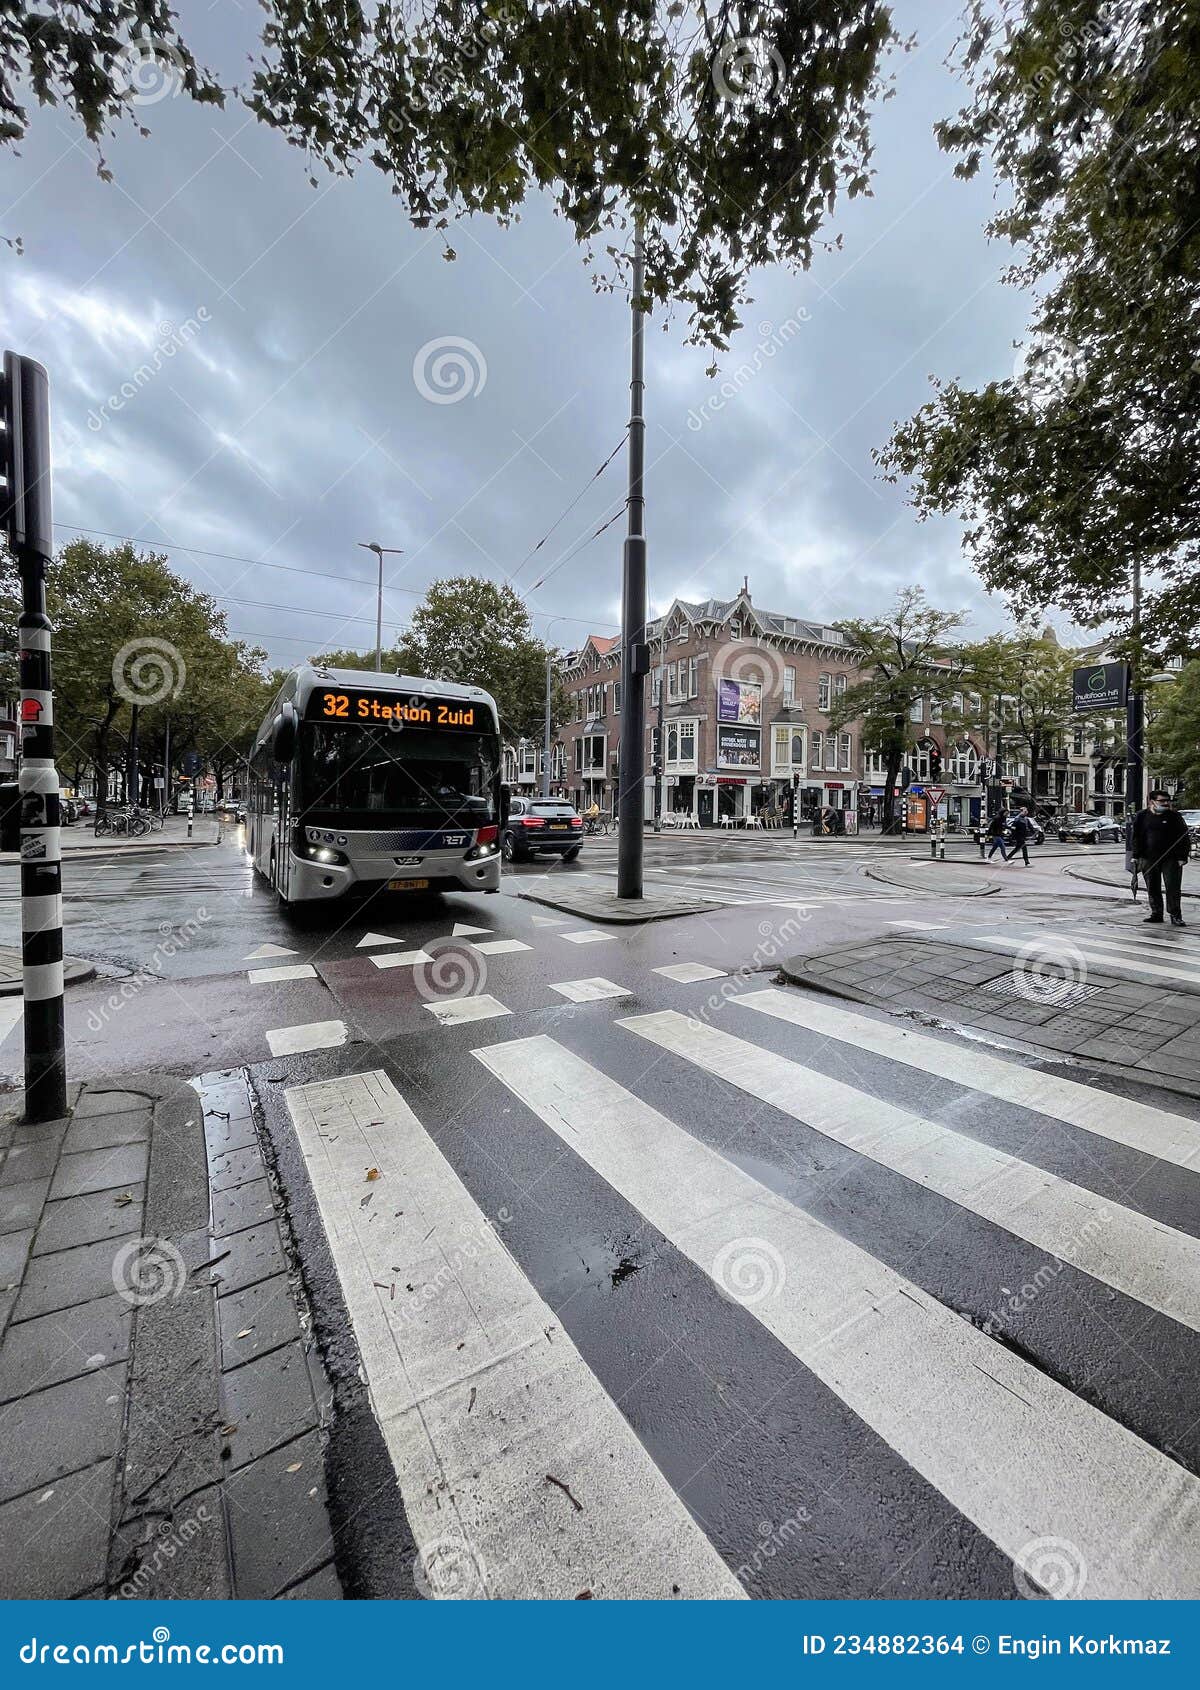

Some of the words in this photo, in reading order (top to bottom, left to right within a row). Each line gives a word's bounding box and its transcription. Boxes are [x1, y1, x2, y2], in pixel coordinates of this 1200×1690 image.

[323, 694, 349, 717] 32
[357, 698, 431, 723] Station
[437, 705, 474, 726] Zuid
